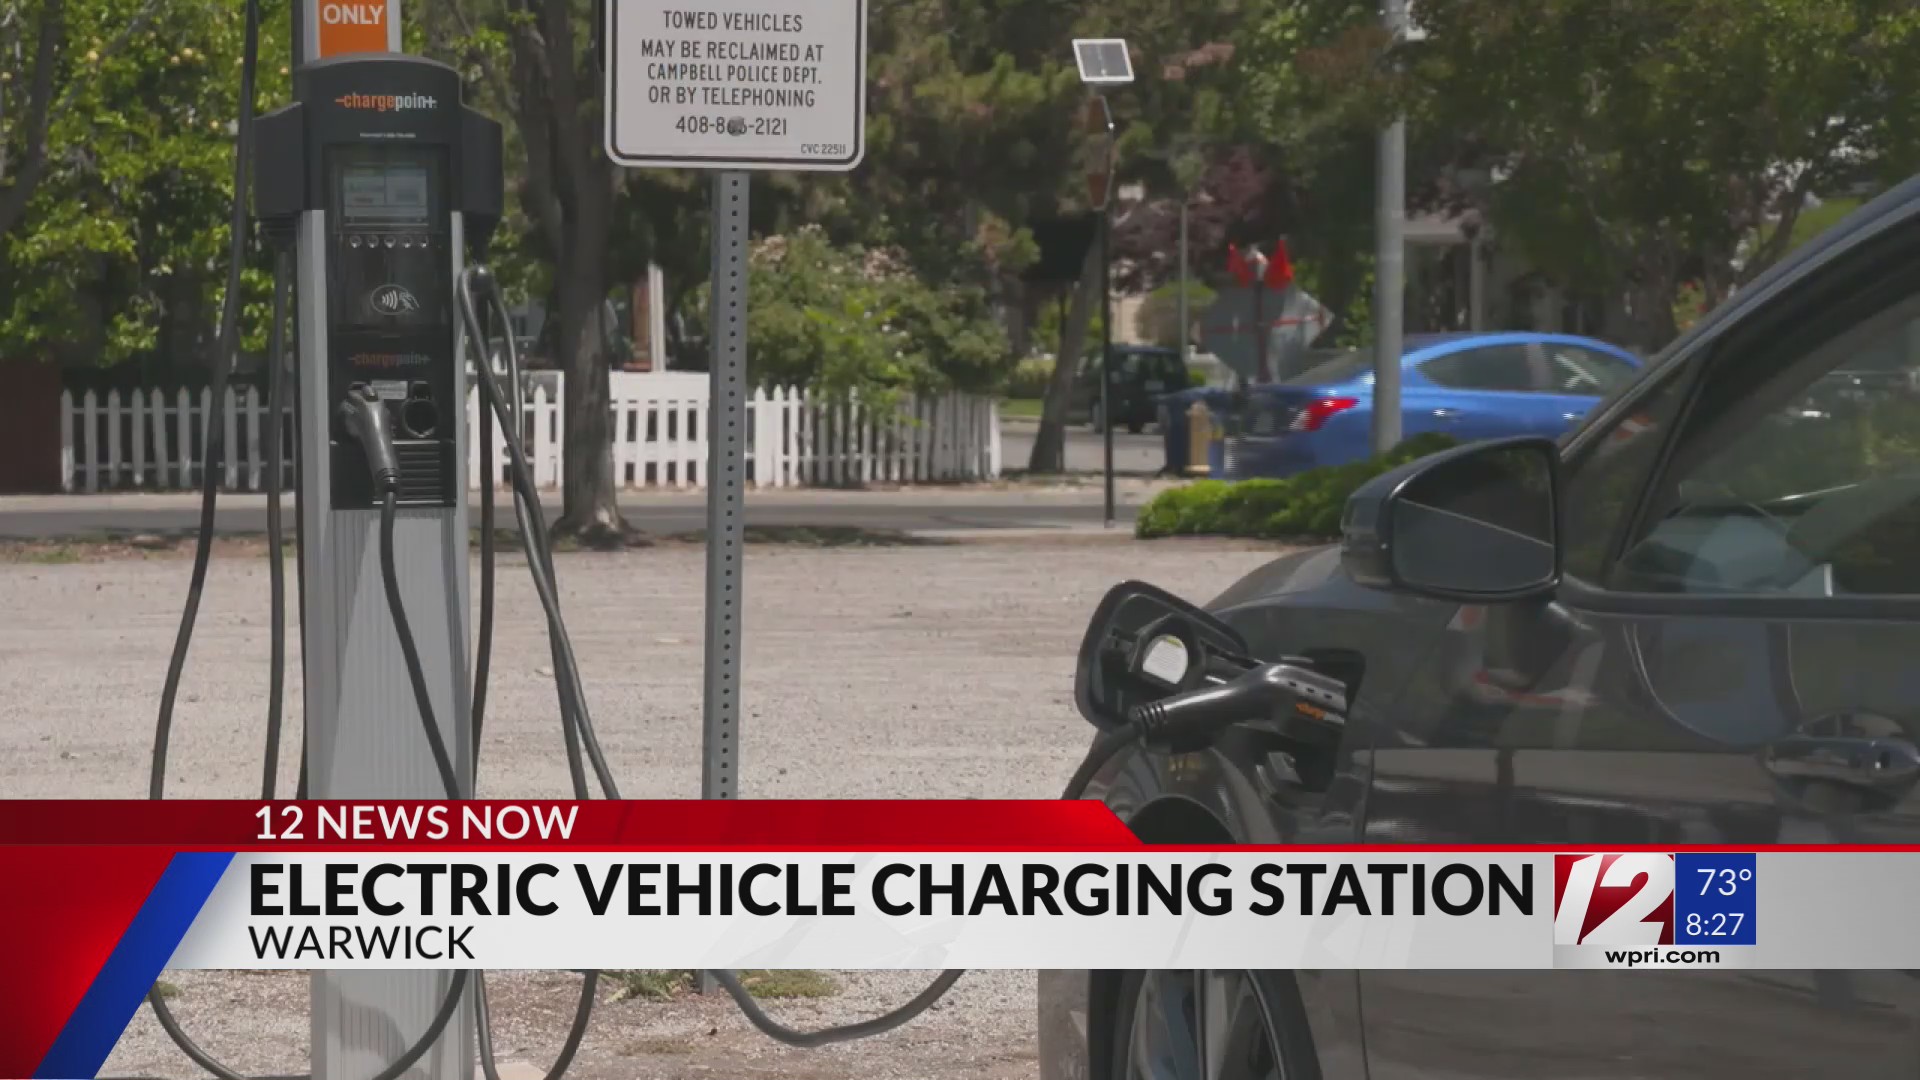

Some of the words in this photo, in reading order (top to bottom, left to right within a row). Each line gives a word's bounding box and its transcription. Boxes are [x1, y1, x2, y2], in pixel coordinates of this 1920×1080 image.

[323, 4, 383, 25] ONLY
[663, 10, 718, 30] TOWED
[722, 13, 803, 32] VEHICLES
[641, 39, 676, 57] MAY
[680, 41, 701, 59] BE
[707, 42, 800, 61] RECLAIMED
[804, 45, 824, 62] AT
[647, 63, 722, 81] CAMPBELL
[727, 65, 778, 83] POLICE
[782, 66, 823, 85] DEPT.
[648, 85, 671, 103] OR
[676, 87, 697, 104] BY
[702, 87, 815, 107] TELEPHONING
[800, 143, 819, 154] CVC
[821, 143, 847, 155] 22511
